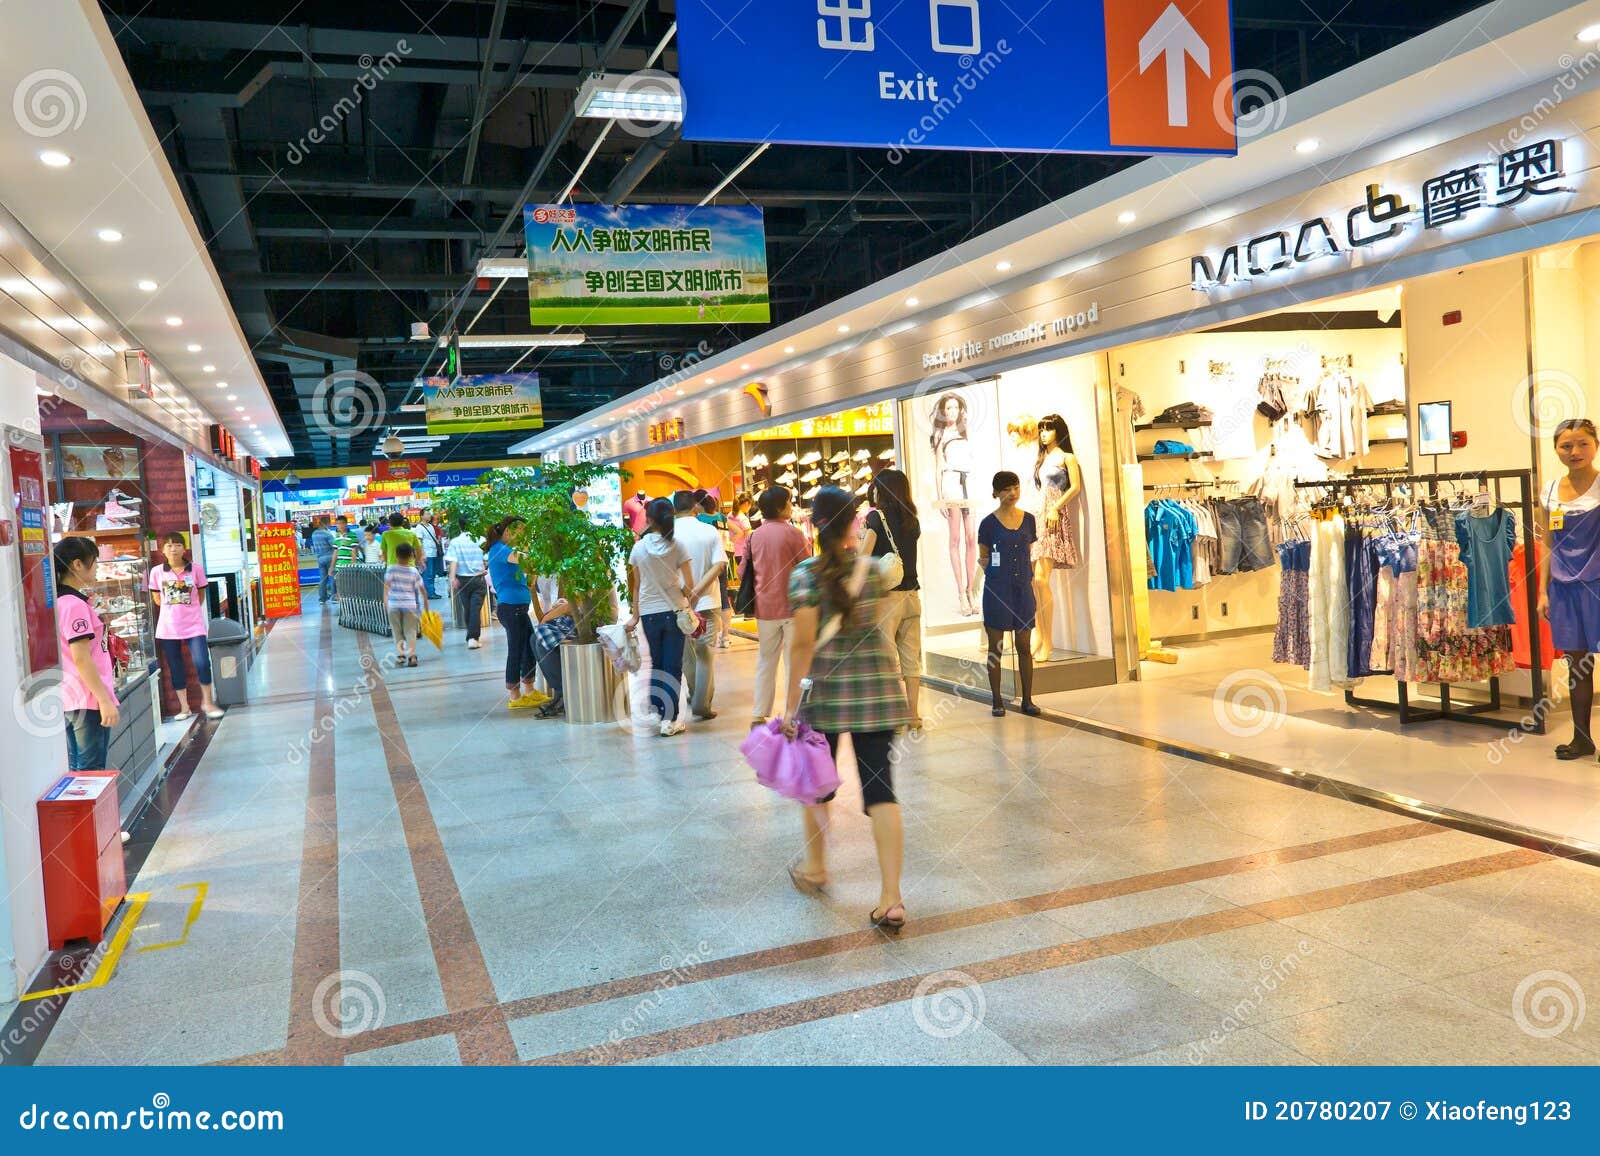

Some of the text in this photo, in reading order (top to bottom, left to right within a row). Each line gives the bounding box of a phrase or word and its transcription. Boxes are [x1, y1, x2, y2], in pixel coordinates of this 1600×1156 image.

[817, 0, 981, 55] 出口
[879, 71, 939, 102] Exit
[1422, 139, 1564, 230] 摩奥
[551, 228, 711, 253] 人人争做文明市民
[585, 269, 742, 293] 争创全国文明城市
[962, 337, 984, 358] the
[988, 320, 1046, 351] romantic
[1052, 301, 1099, 335] mood
[817, 420, 844, 433] SALE
